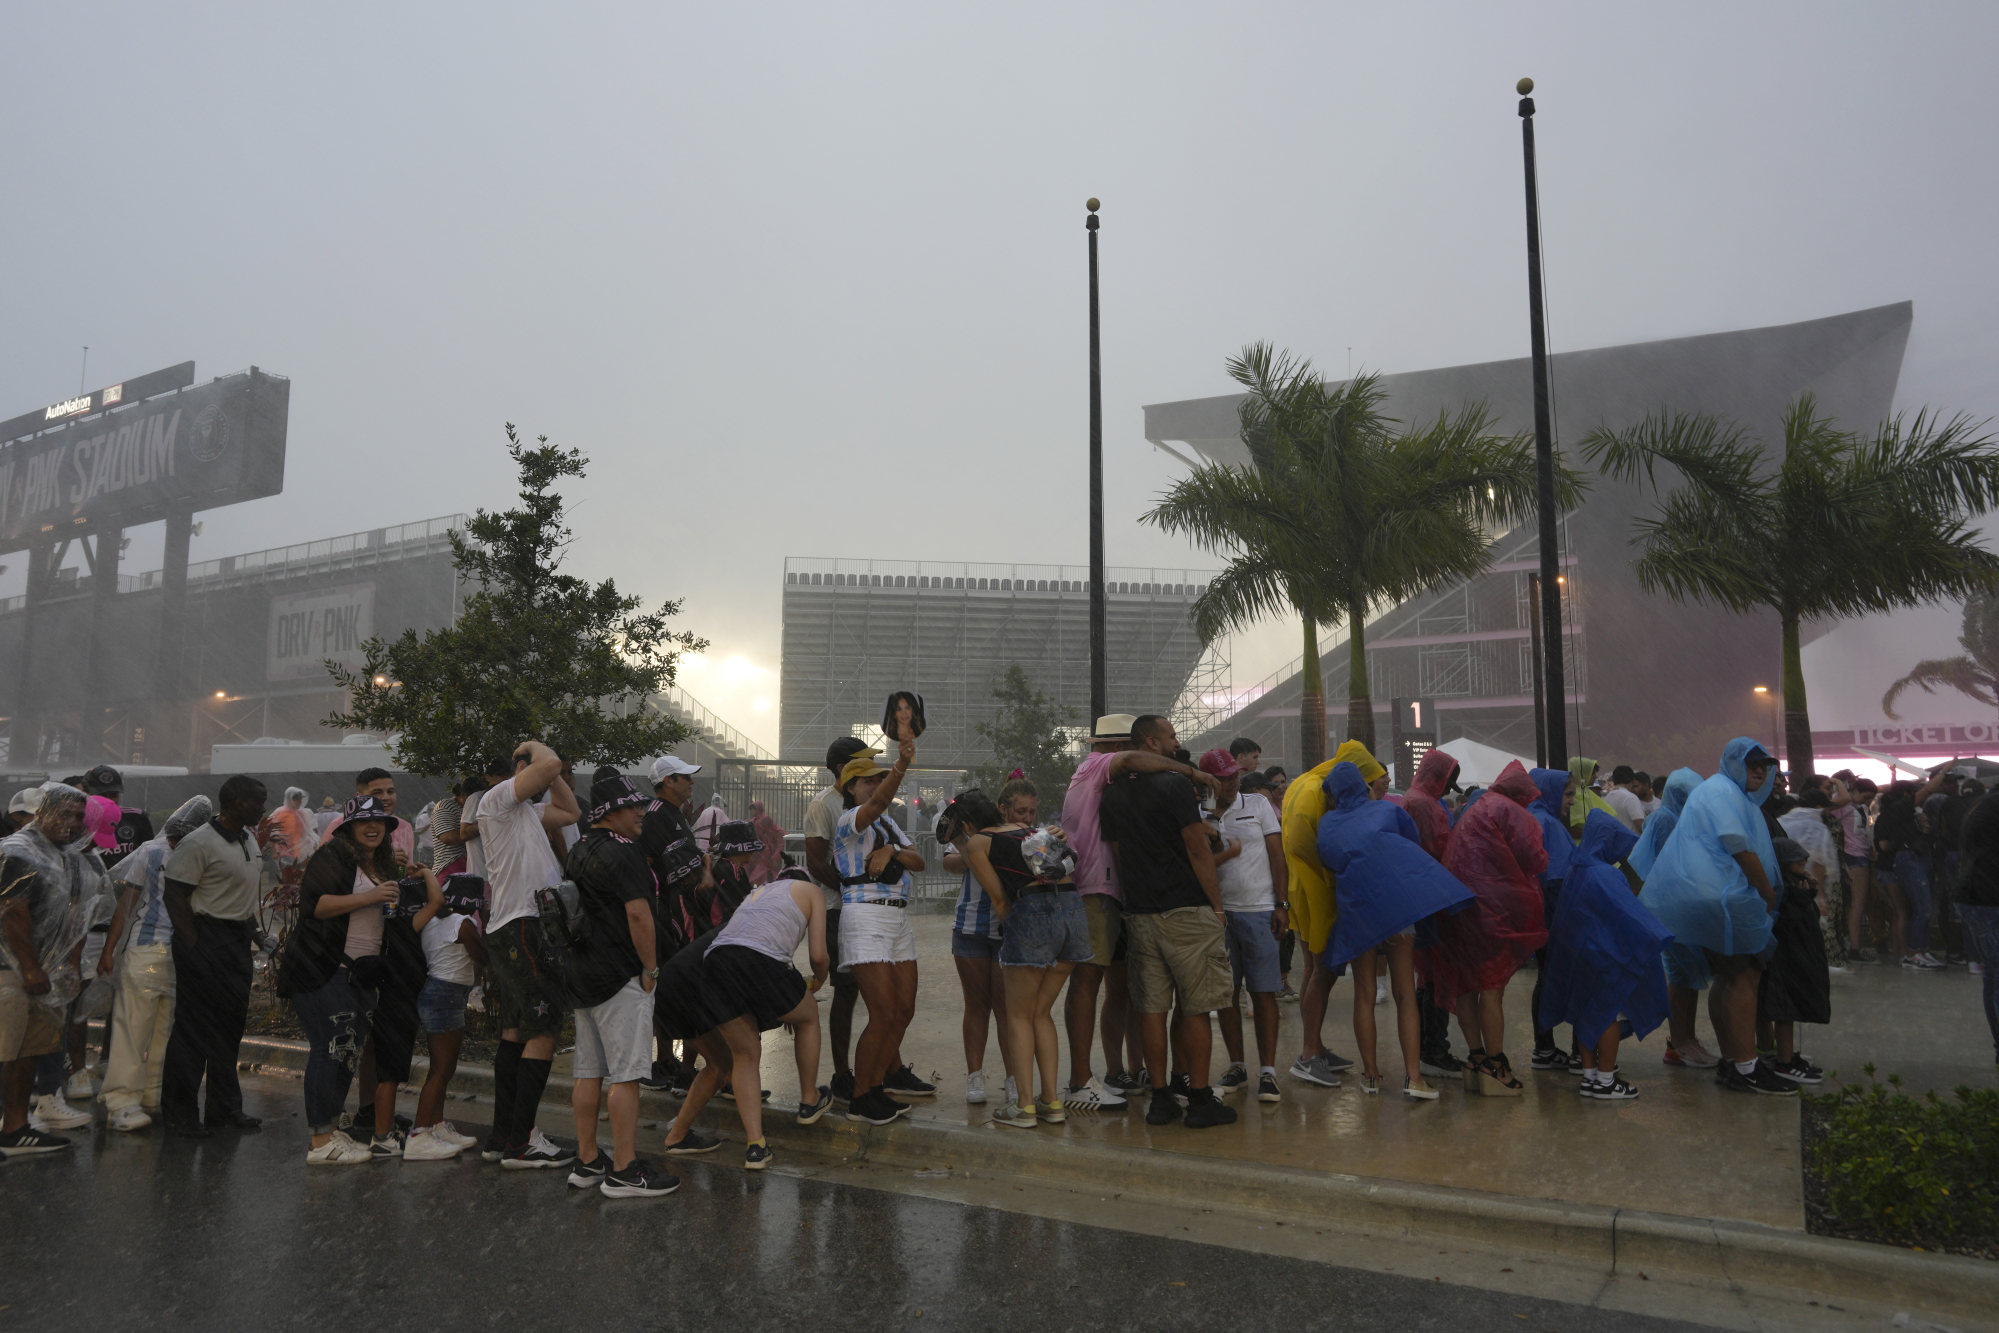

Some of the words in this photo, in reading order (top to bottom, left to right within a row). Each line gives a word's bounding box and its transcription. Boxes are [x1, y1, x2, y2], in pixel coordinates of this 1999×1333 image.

[45, 396, 91, 420] AutoNation
[70, 409, 182, 504] STADIUM
[277, 611, 315, 659] DRV
[322, 604, 361, 653] PNK
[1410, 702, 1421, 728] 1
[1849, 722, 1956, 745] TICKET
